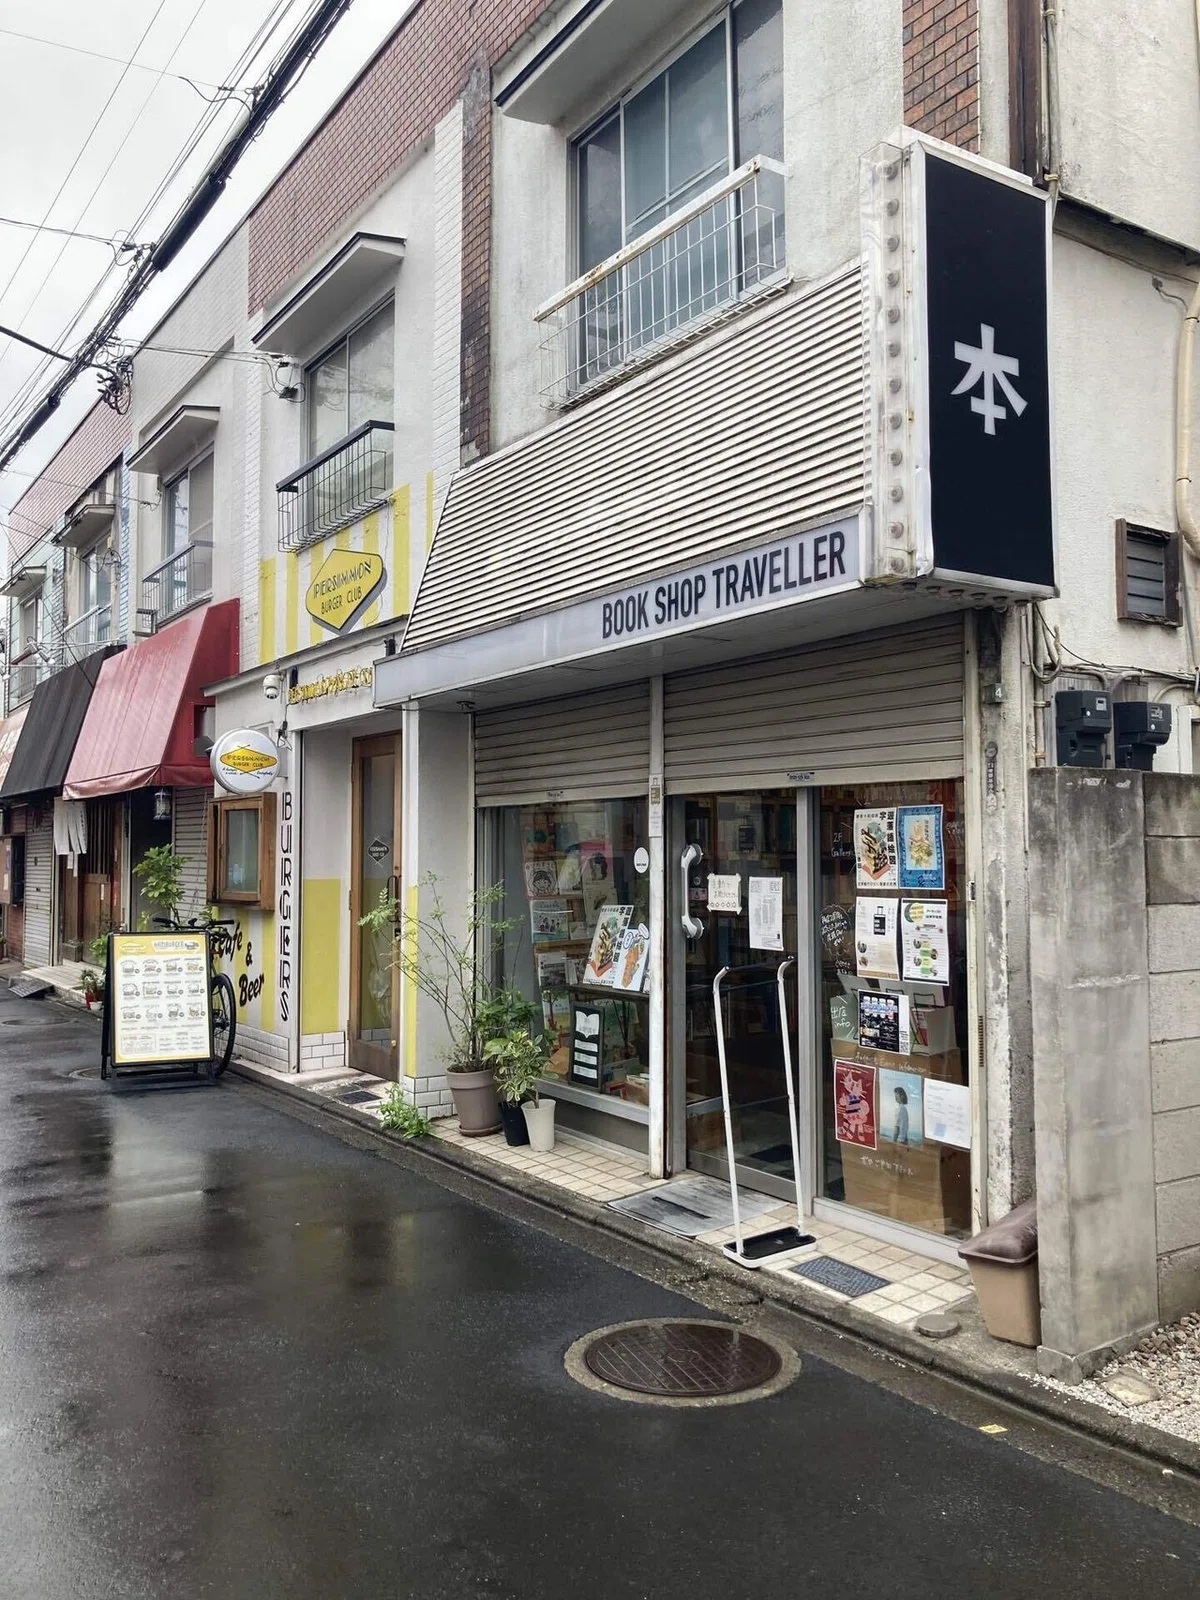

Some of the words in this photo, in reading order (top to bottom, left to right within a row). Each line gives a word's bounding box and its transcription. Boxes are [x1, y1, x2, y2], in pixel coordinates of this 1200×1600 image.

[950, 322, 1028, 436] 本
[313, 558, 372, 599] PERSIMMON
[602, 591, 650, 639] BOOK
[654, 574, 706, 625] SHOP
[712, 530, 846, 609] TRAVELLER
[320, 594, 343, 615] BURGER
[346, 586, 363, 604] CLUB
[995, 687, 1002, 698] 4
[280, 791, 294, 1022] BURGERS
[246, 941, 253, 967] &
[238, 973, 265, 1007] Beer
[833, 1018, 851, 1029] info
